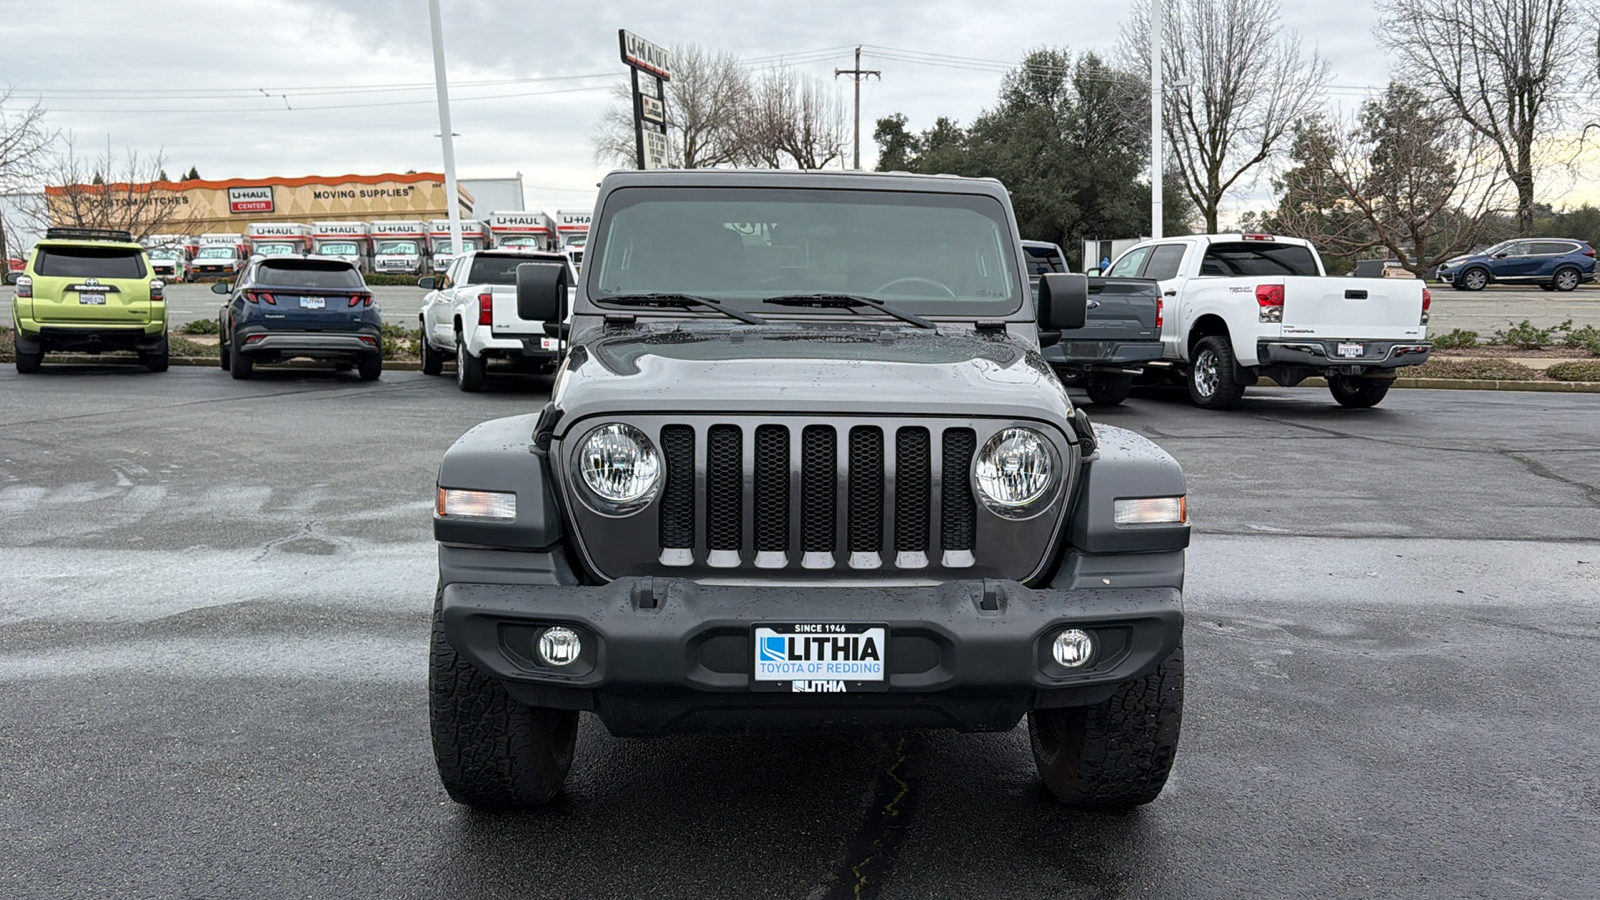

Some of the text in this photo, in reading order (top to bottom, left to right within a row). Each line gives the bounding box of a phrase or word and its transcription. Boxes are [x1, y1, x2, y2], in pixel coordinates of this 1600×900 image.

[232, 190, 269, 199] U-HAUL
[313, 189, 356, 200] MOVING
[360, 187, 409, 198] SUPPLIES
[237, 202, 266, 210] CENTER
[497, 216, 541, 225] U-HAUL
[256, 227, 295, 236] U-HAUL
[319, 226, 358, 234] U-HAUL
[377, 225, 417, 233] U-HAUL
[795, 624, 846, 633] SINCE 1946
[788, 637, 880, 661] LITHIA
[760, 663, 880, 673] TOYOTA OF REDDING
[804, 680, 847, 693] LITHIA
